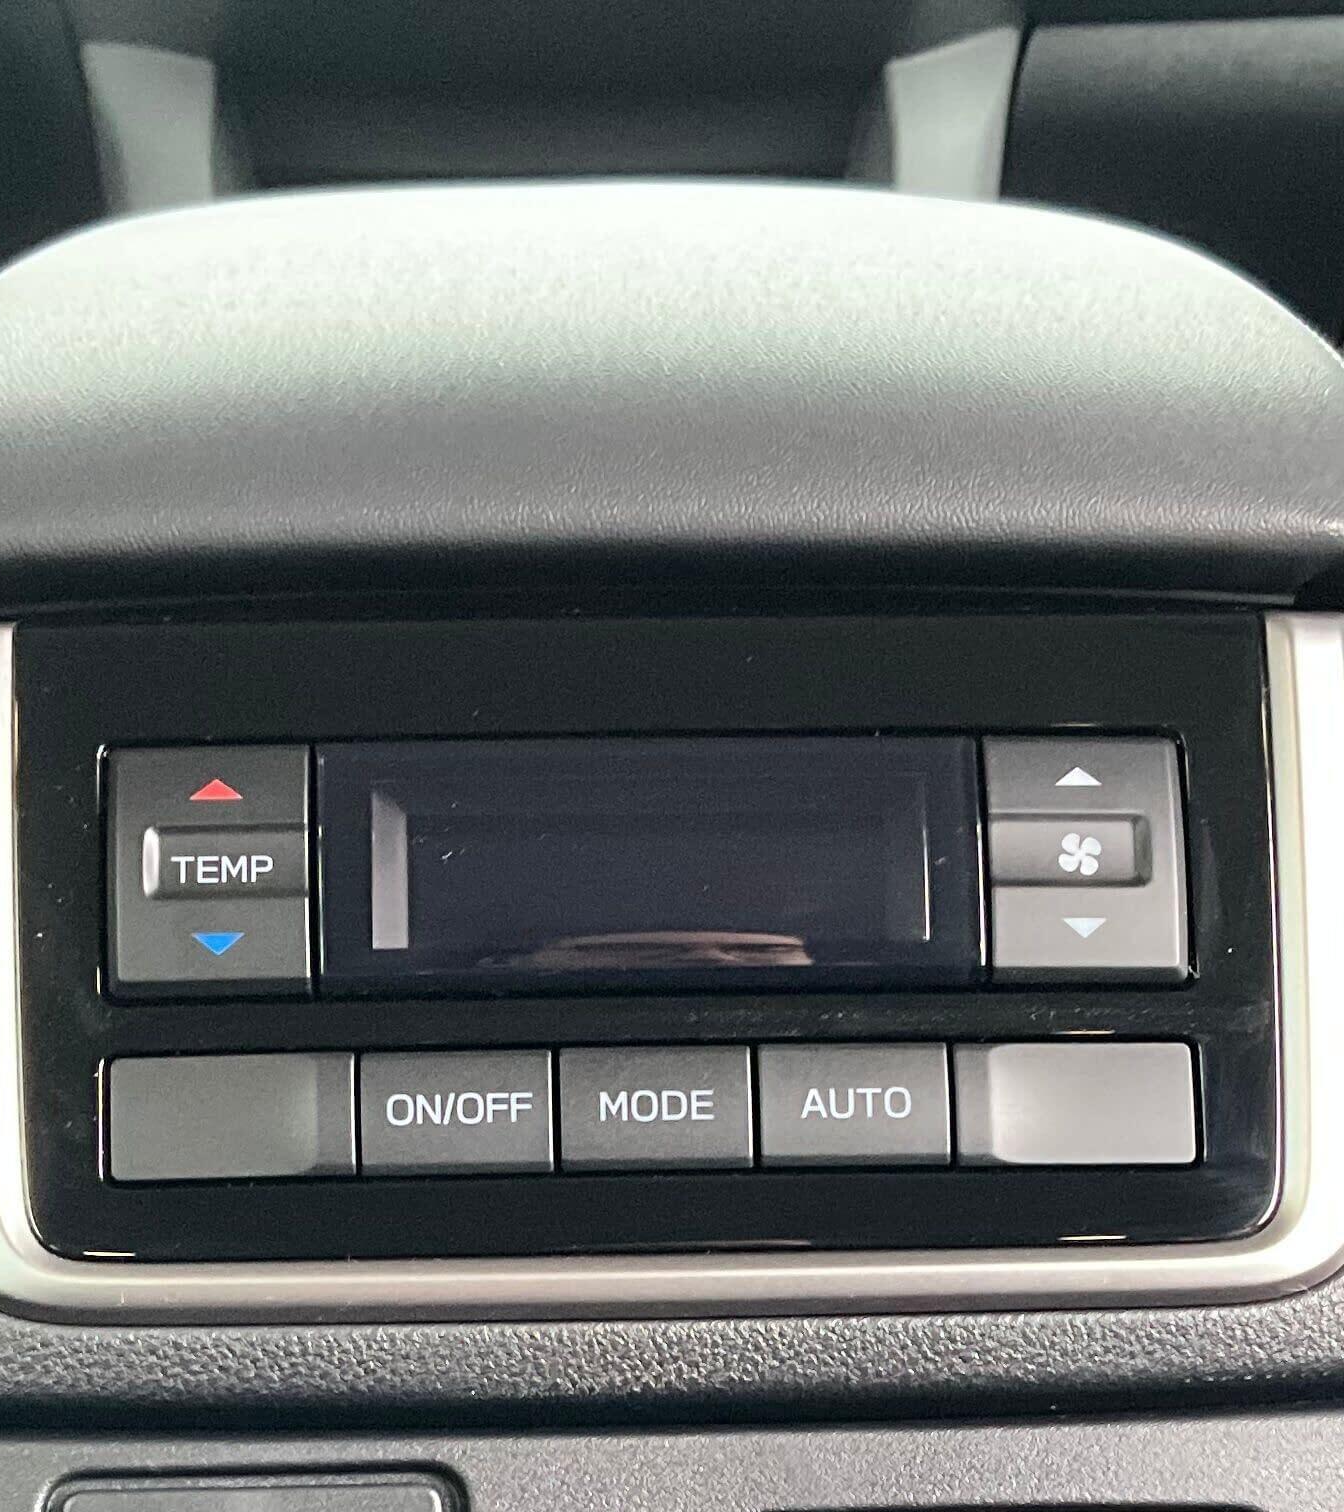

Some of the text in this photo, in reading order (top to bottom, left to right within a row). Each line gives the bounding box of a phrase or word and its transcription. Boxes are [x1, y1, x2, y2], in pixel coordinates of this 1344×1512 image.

[170, 855, 274, 884] TEMP
[385, 1091, 533, 1127] ON/OFF
[598, 1089, 715, 1122] MODE
[800, 1086, 912, 1119] AUTO
